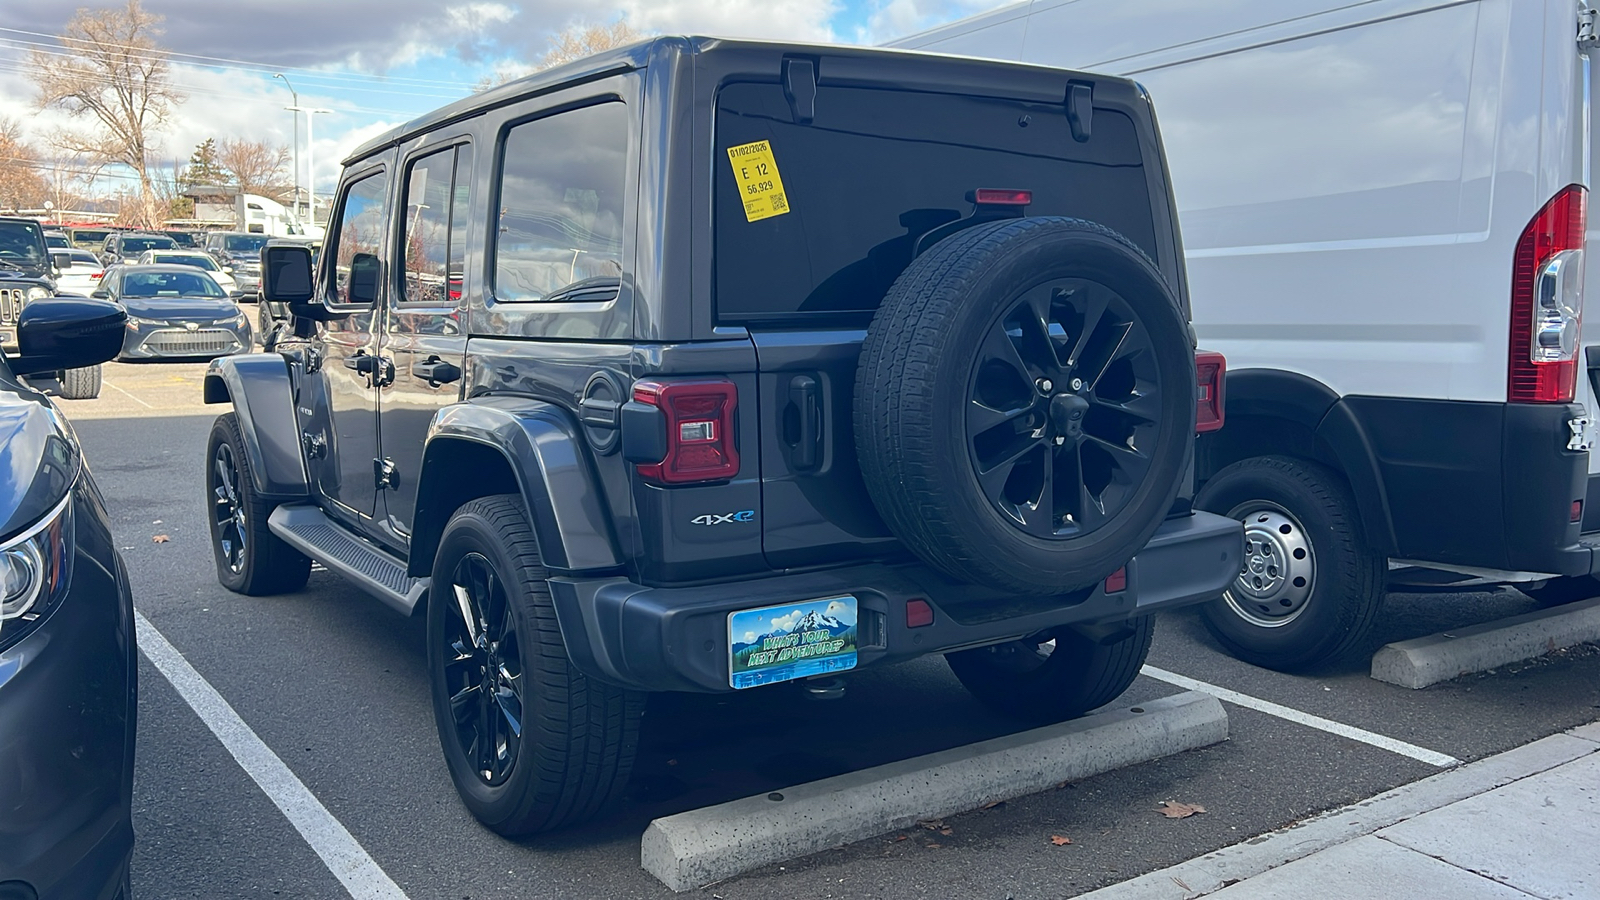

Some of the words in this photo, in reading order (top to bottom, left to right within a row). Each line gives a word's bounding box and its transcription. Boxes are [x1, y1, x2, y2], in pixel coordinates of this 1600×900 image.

[729, 142, 767, 158] 01/02/2026
[741, 167, 750, 180] E
[755, 162, 769, 176] 12
[746, 180, 774, 195] 56,929
[763, 633, 799, 650] WHAT'S
[801, 629, 830, 644] YOUR
[747, 650, 778, 667] NEXT
[777, 639, 845, 662] ADVENTURE?
